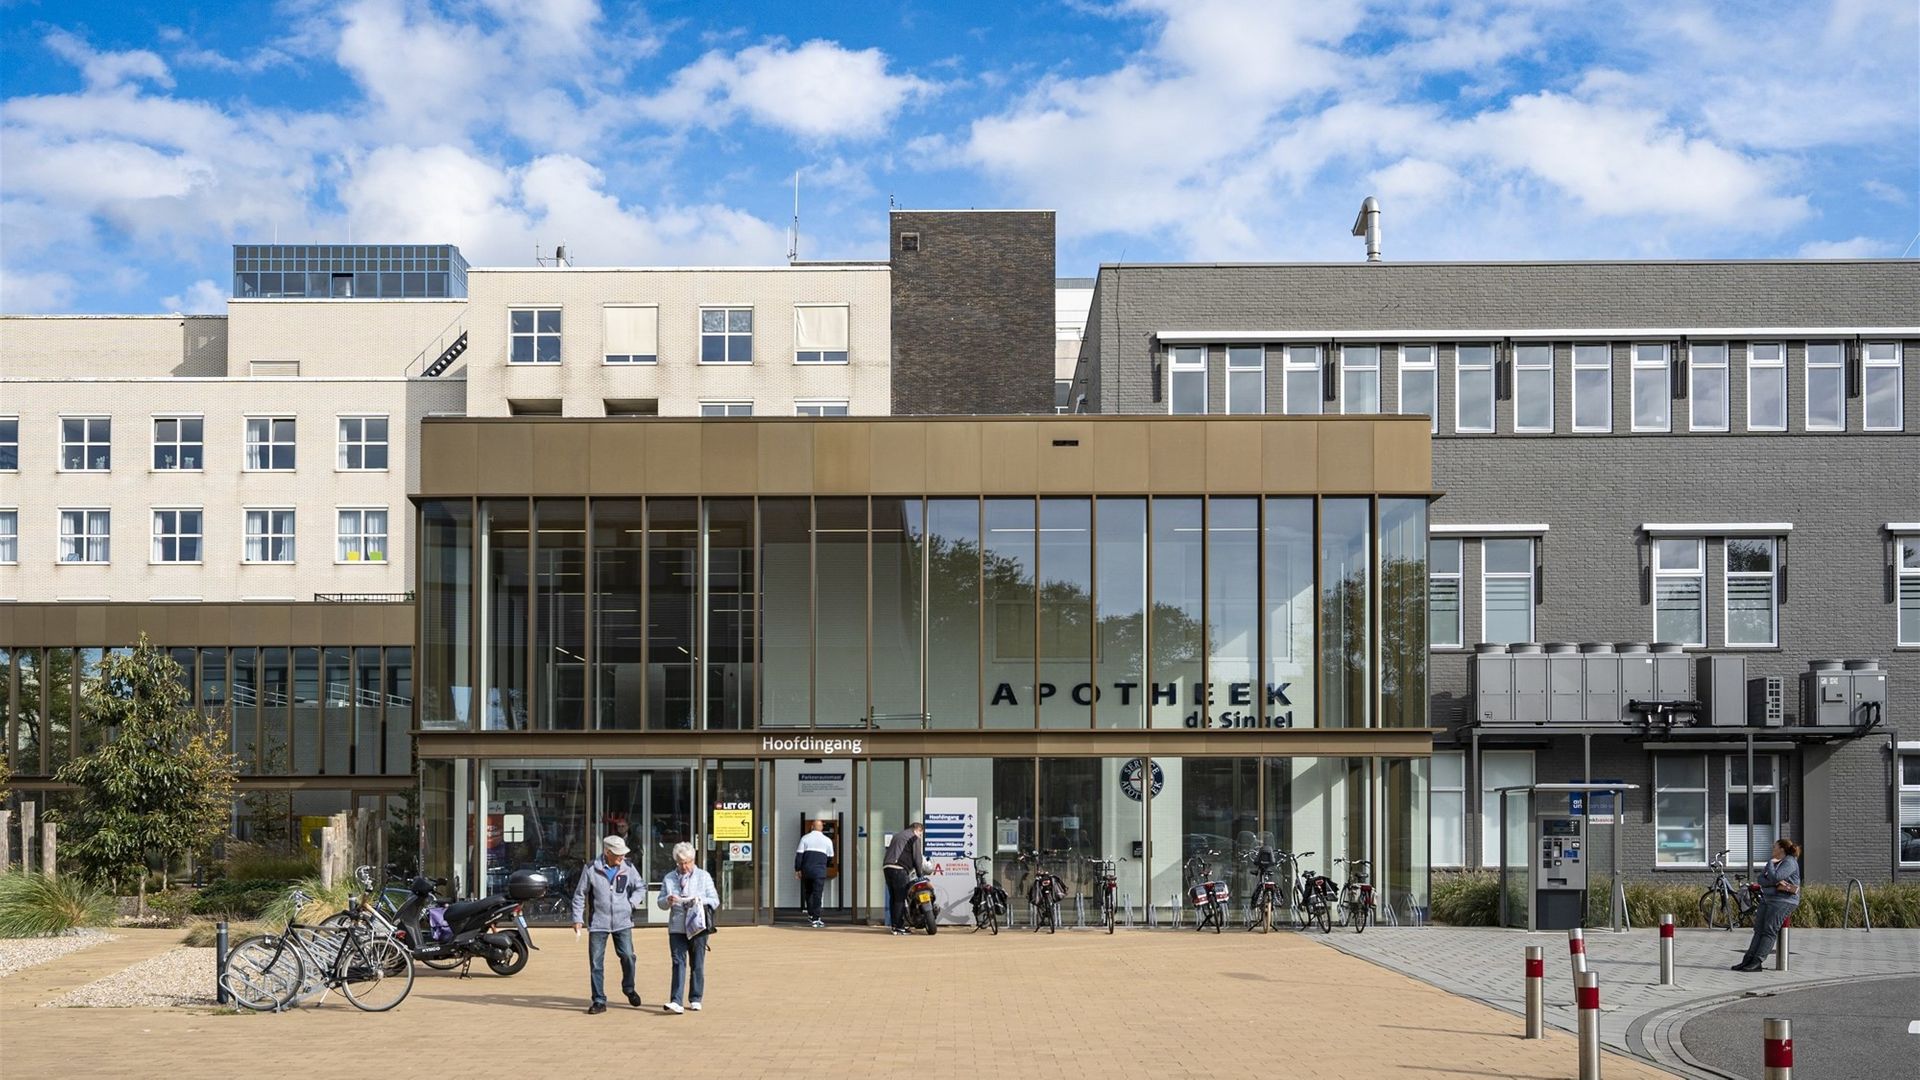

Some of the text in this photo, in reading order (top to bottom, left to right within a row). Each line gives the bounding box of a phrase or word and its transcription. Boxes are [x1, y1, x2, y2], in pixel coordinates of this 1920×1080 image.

[991, 682, 1292, 706] APOTHEEK
[762, 736, 862, 754] Hoofdingang
[723, 802, 737, 810] LET
[737, 802, 751, 810] OP!
